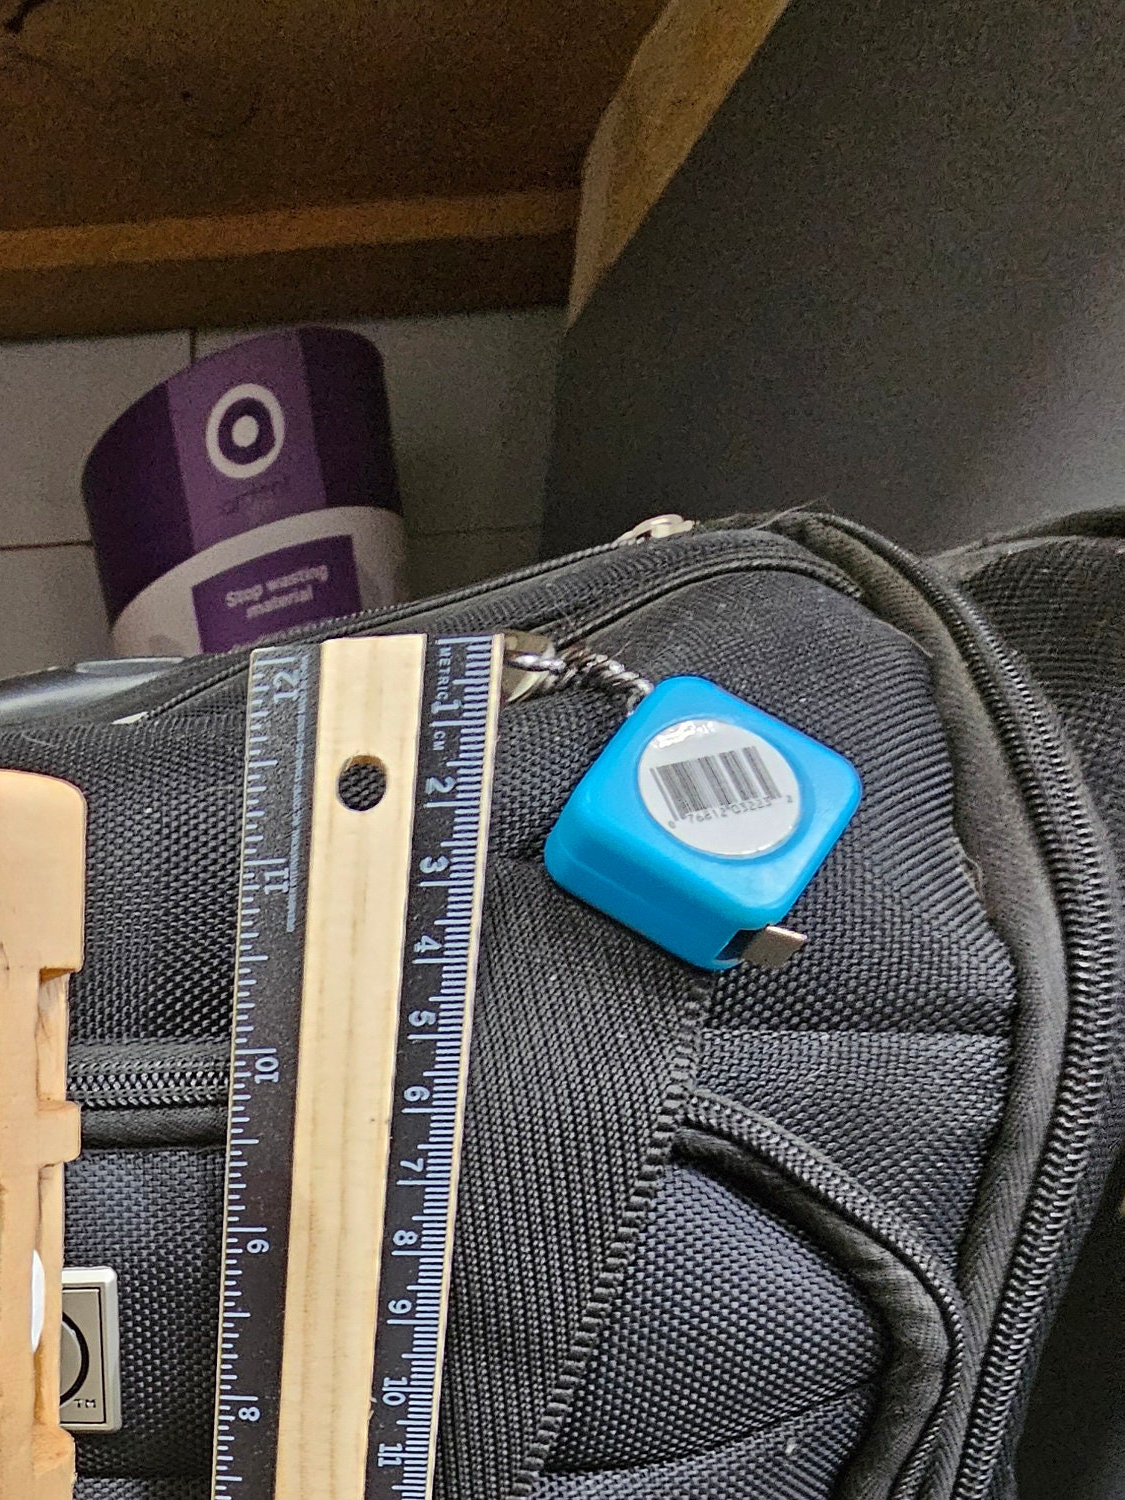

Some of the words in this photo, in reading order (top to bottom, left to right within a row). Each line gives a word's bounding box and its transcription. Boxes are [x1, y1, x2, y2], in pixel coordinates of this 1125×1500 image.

[246, 584, 314, 619] material
[436, 646, 452, 705] METRIC
[272, 671, 300, 700] 12
[430, 700, 462, 715] 1
[432, 730, 446, 751] CM
[426, 776, 457, 794] 2
[419, 856, 450, 874] 3
[264, 867, 290, 895] 11
[413, 935, 443, 952] 4
[408, 1010, 437, 1027] 5
[254, 1056, 279, 1084] 10
[403, 1086, 430, 1102] 6
[400, 1158, 424, 1173] 7
[246, 1239, 270, 1254] 9
[392, 1229, 418, 1246] 8
[387, 1299, 412, 1315] 9
[382, 1377, 408, 1406] 10
[238, 1406, 261, 1422] 8
[378, 1443, 403, 1467] 11
